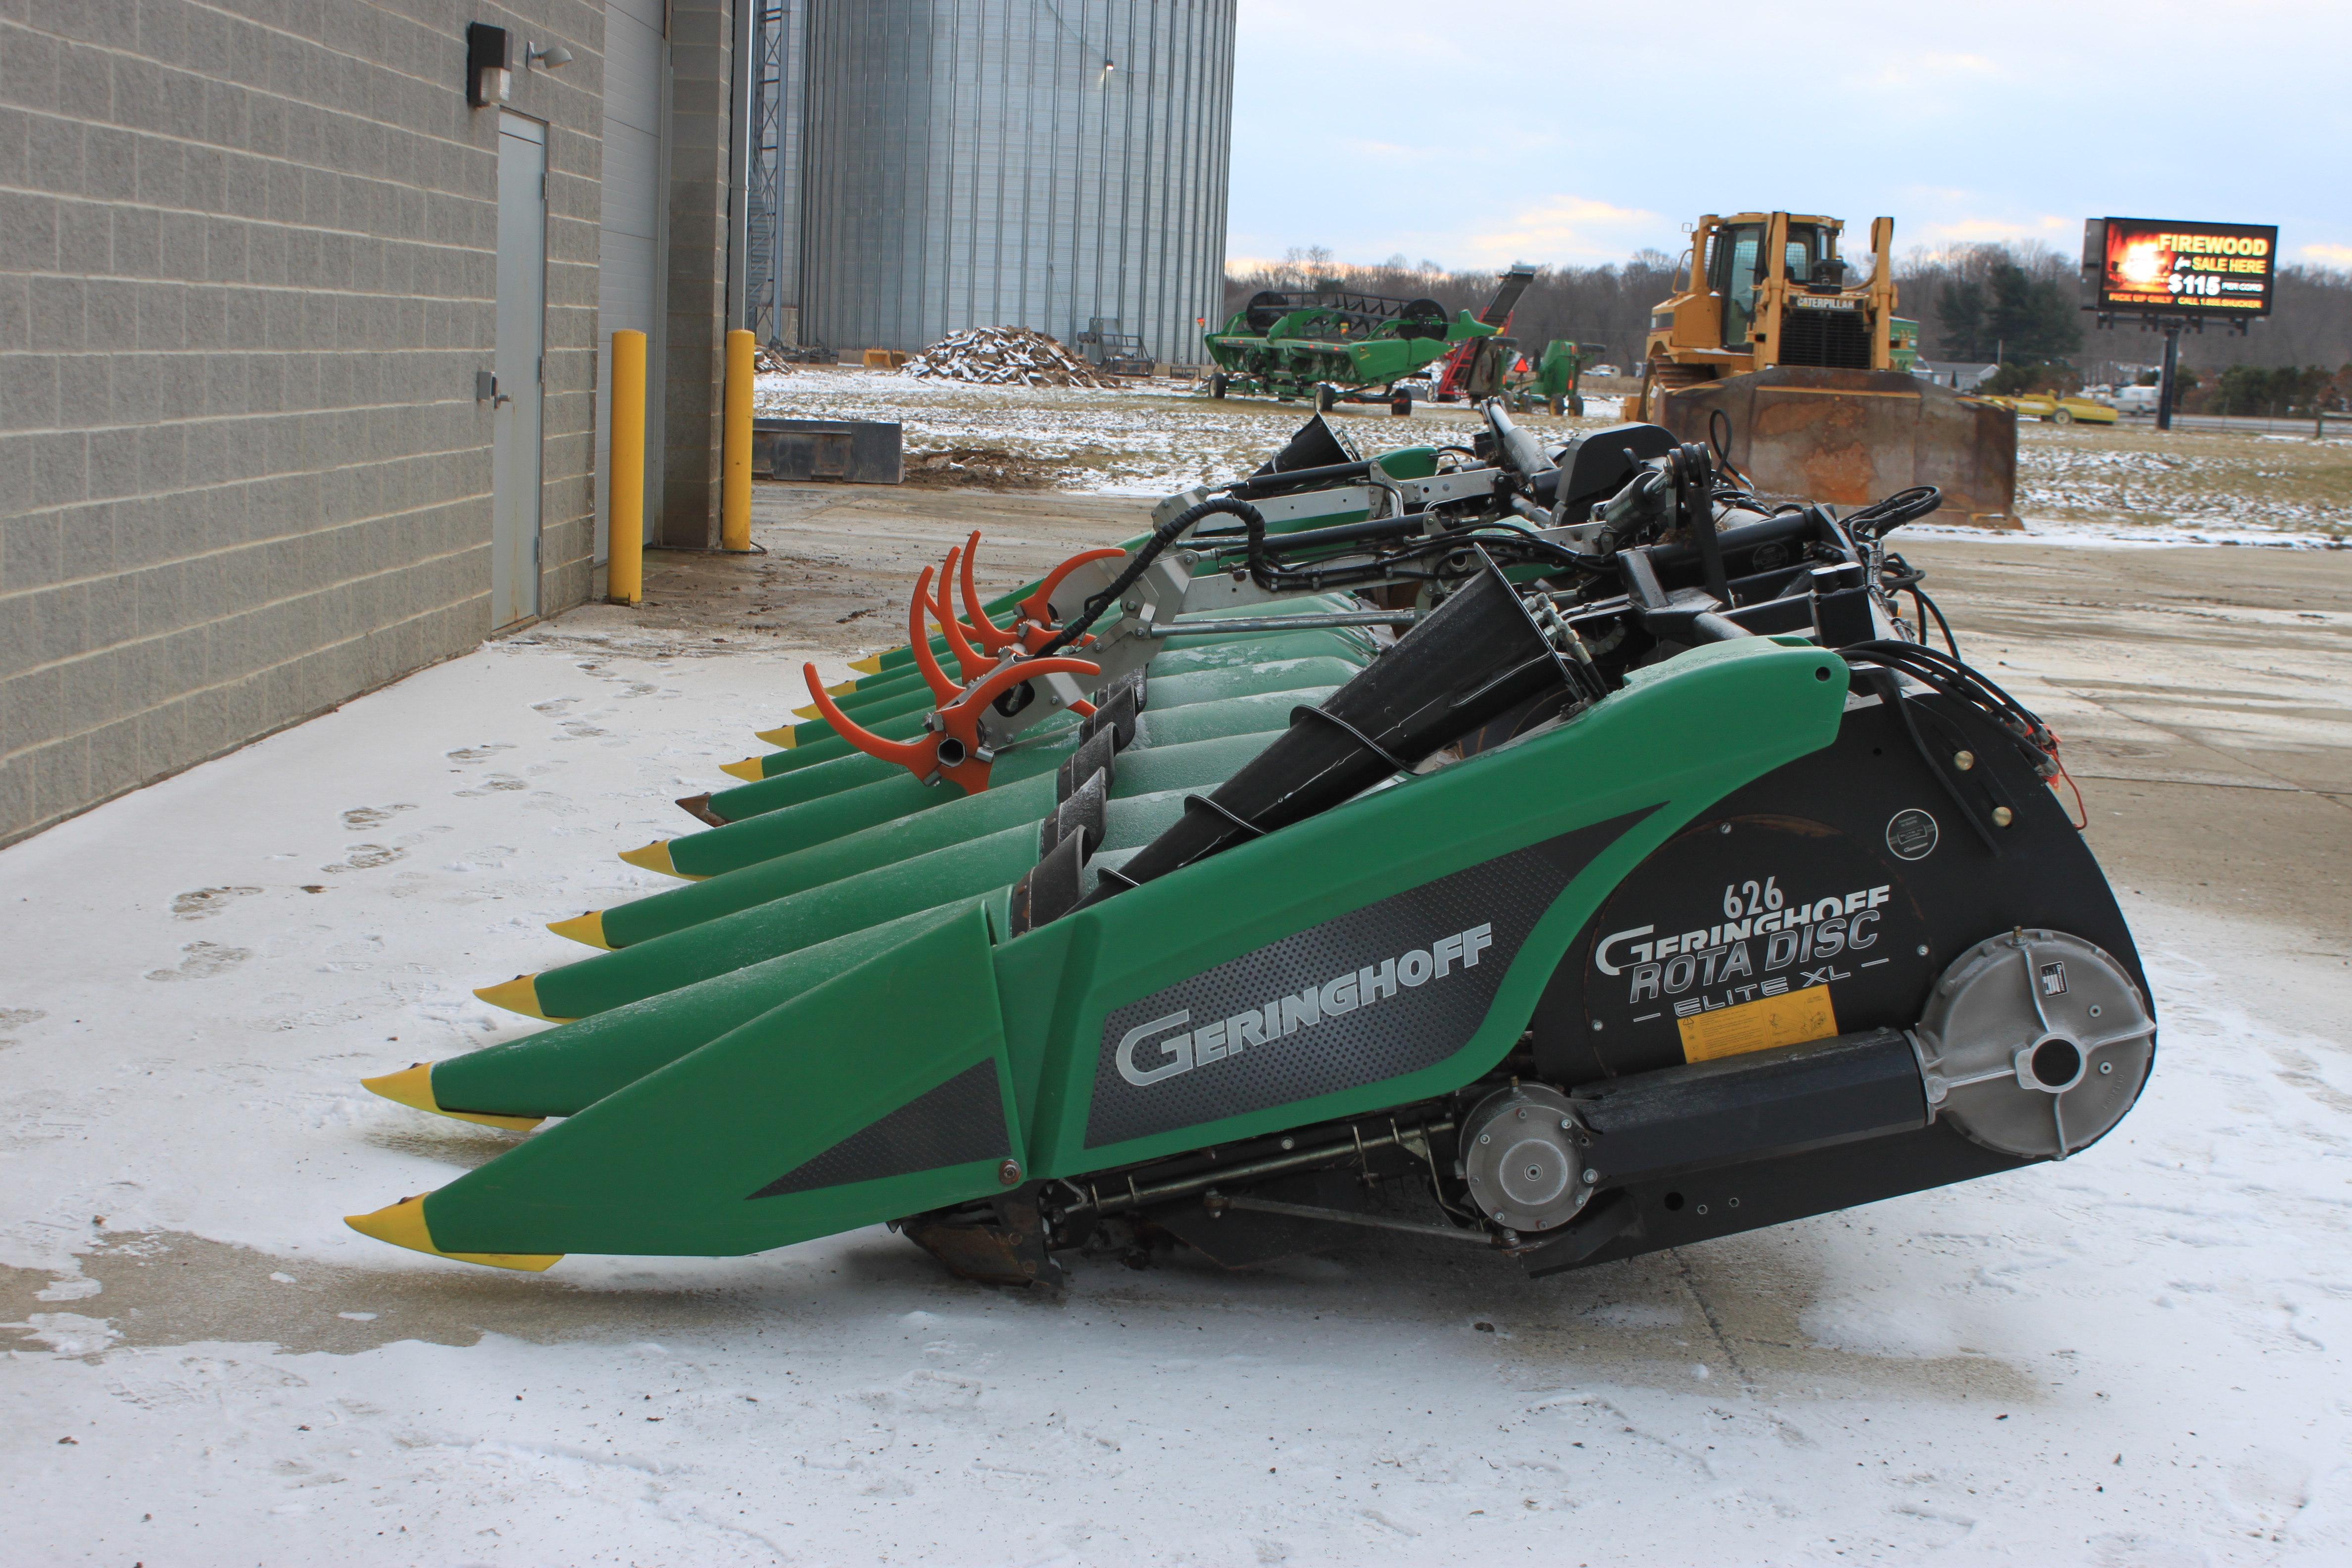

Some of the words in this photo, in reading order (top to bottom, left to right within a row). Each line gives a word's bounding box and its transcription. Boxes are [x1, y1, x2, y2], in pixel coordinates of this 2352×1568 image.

[2158, 233, 2269, 256] FIREWOOD
[2192, 255, 2228, 272] SALE
[2228, 258, 2267, 274] HERE
[2109, 292, 2133, 301] PICK
[2133, 294, 2148, 302] UP
[2147, 294, 2174, 304] ONLY
[2177, 296, 2200, 306] CALL
[2167, 273, 2221, 296] $115
[2221, 282, 2239, 291] PER
[2239, 283, 2264, 292] CORD
[1797, 297, 1855, 309] CATERPILLAR
[1723, 876, 1783, 919] 626
[1595, 884, 1890, 976] GERINGHOFF
[1629, 941, 1753, 1003] ROTA
[1764, 910, 1880, 971] DISC
[1116, 922, 1492, 1086] GERINGHOFF
[1673, 977, 1789, 1017] ELITE
[1800, 966, 1851, 988] XL
